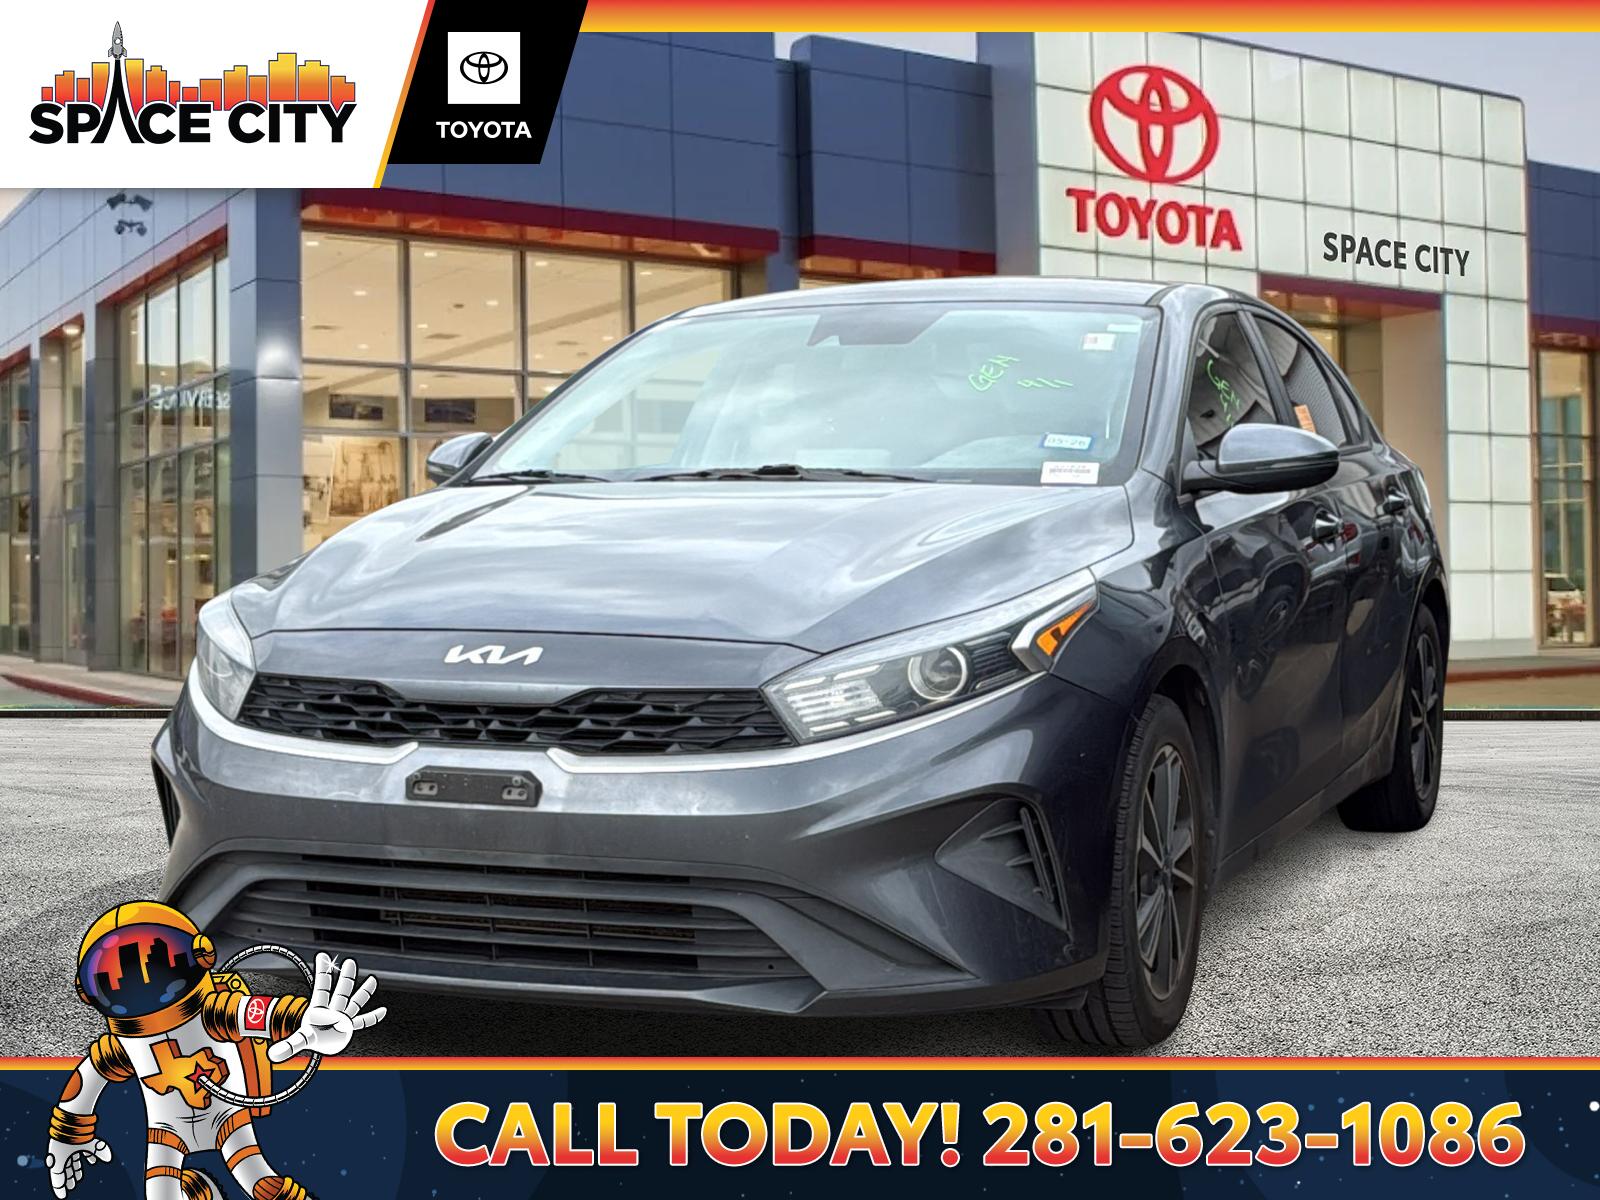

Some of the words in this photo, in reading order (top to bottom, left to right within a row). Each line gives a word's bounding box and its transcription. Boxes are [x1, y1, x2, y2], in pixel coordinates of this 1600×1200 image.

[1066, 187, 1242, 251] TOYOTA
[1323, 232, 1407, 270] SPACE
[1414, 244, 1471, 277] CITY
